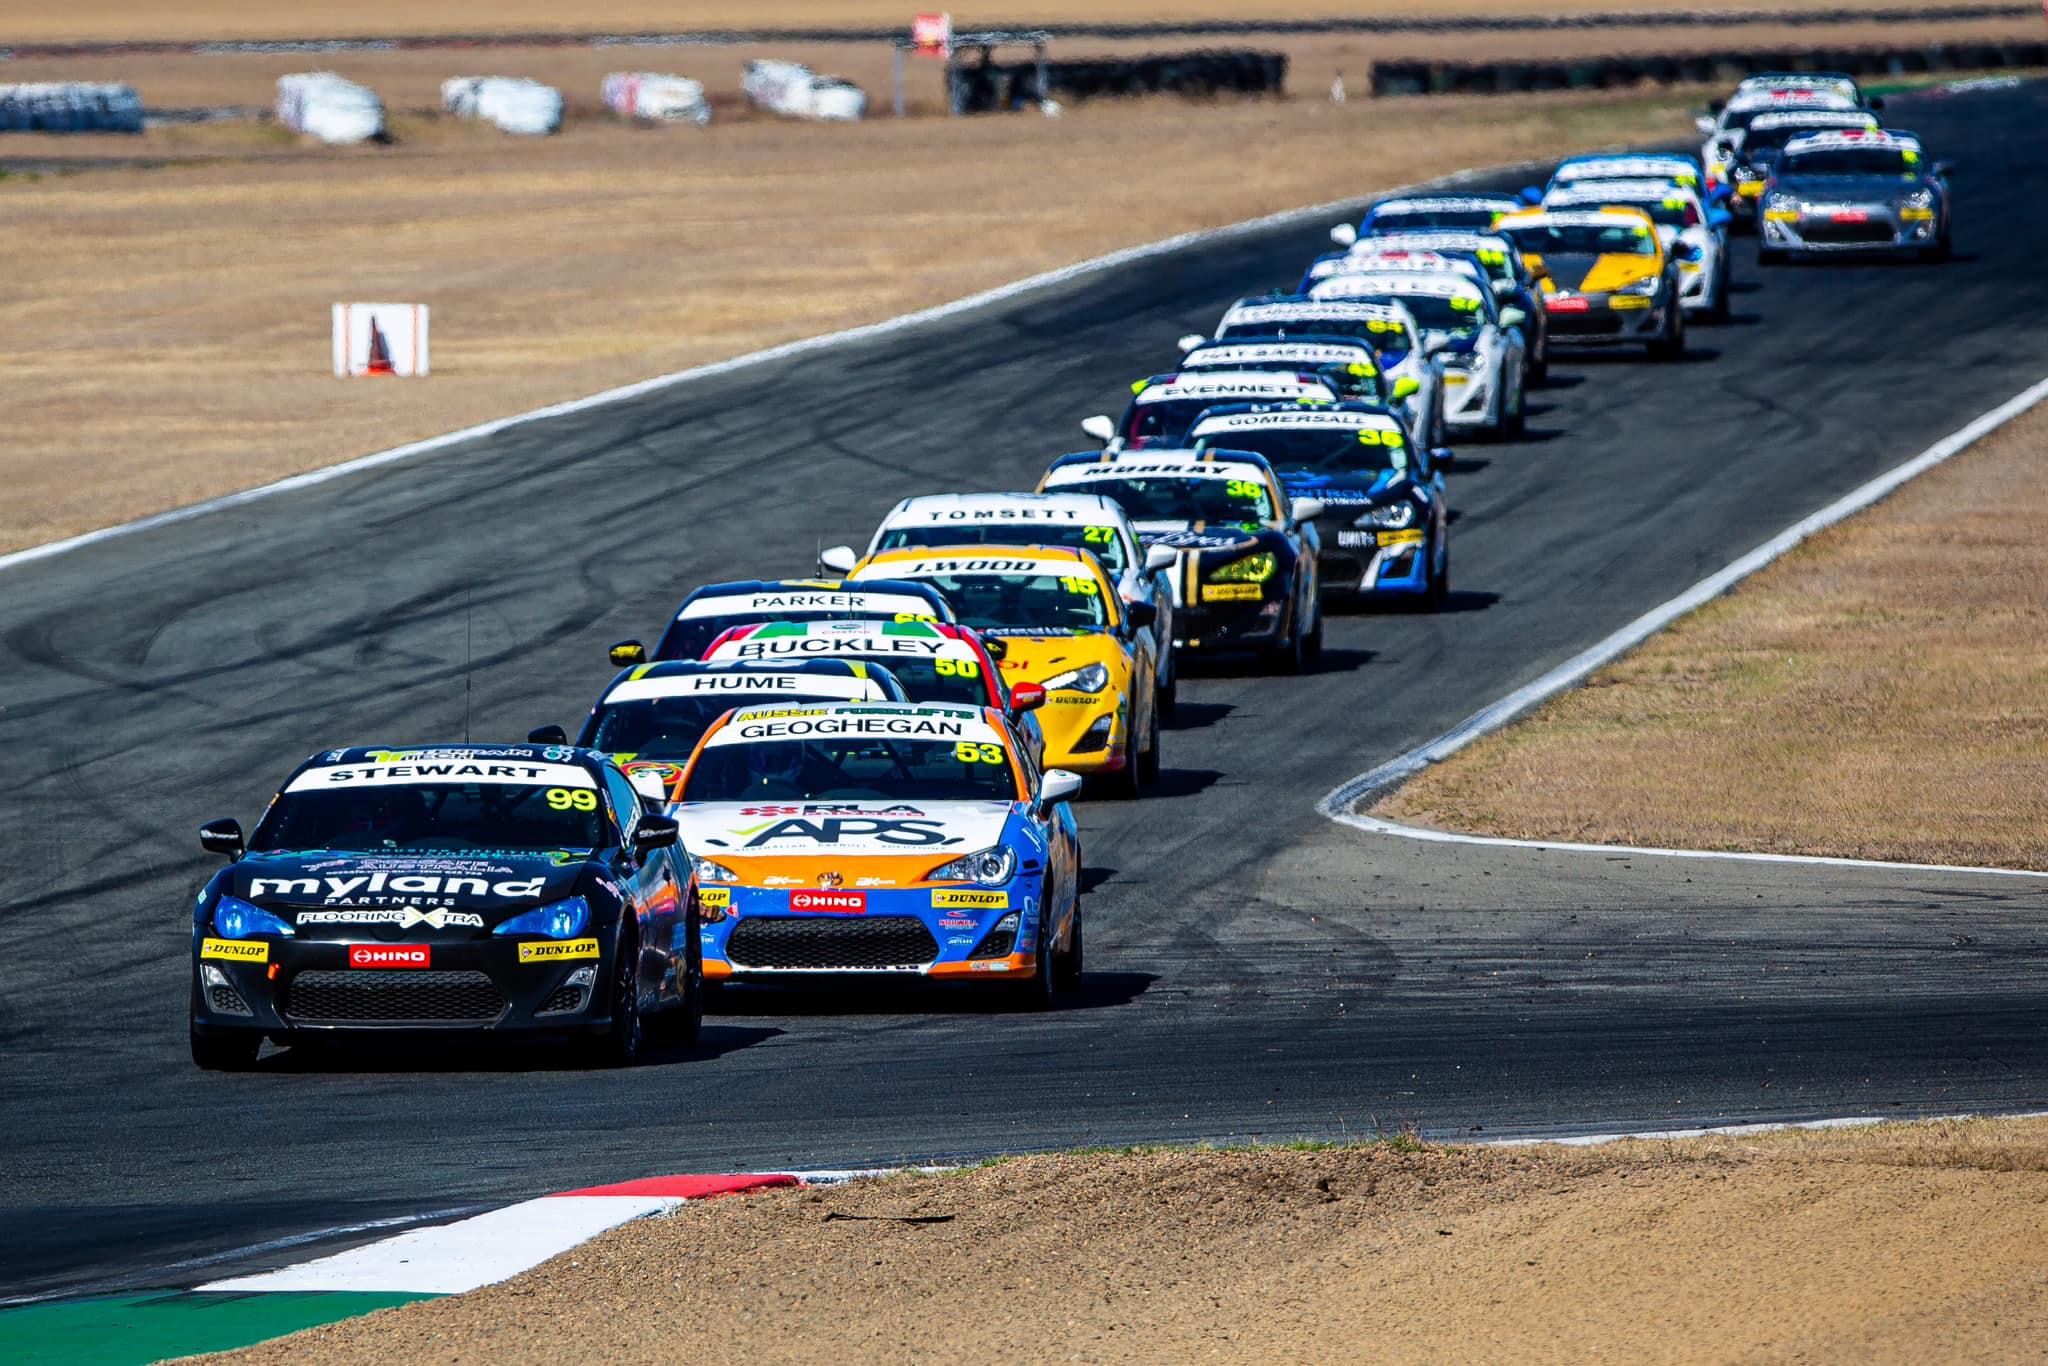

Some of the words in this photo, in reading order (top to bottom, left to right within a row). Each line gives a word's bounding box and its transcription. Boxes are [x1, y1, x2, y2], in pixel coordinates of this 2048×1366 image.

[1164, 384, 1307, 396] EVENNETT
[1228, 414, 1366, 426] GOMERSALL
[1083, 464, 1231, 476] MURRAY
[1226, 480, 1262, 499] 36
[930, 509, 1078, 520] TOMSETT
[1083, 526, 1115, 544] 27
[905, 560, 1037, 574] J.WOOD
[1060, 576, 1098, 595] 15
[752, 595, 865, 608] PARKER
[738, 638, 945, 657] BUCKLEY
[935, 657, 980, 678] 50
[694, 677, 796, 690] HUME
[740, 719, 962, 739] GEOGHEGAN
[955, 741, 1004, 764] 53
[329, 763, 547, 781] STEWART
[546, 788, 597, 811] 99
[744, 817, 947, 847] APS
[249, 872, 546, 899] myland
[323, 896, 456, 906] PARTNERS
[699, 892, 727, 902] LOP
[812, 895, 863, 908] HINO
[947, 894, 1005, 904] DUNLOP
[213, 943, 266, 957] DUNLOP
[373, 950, 426, 962] HINO
[534, 943, 597, 956] DUNLOP
